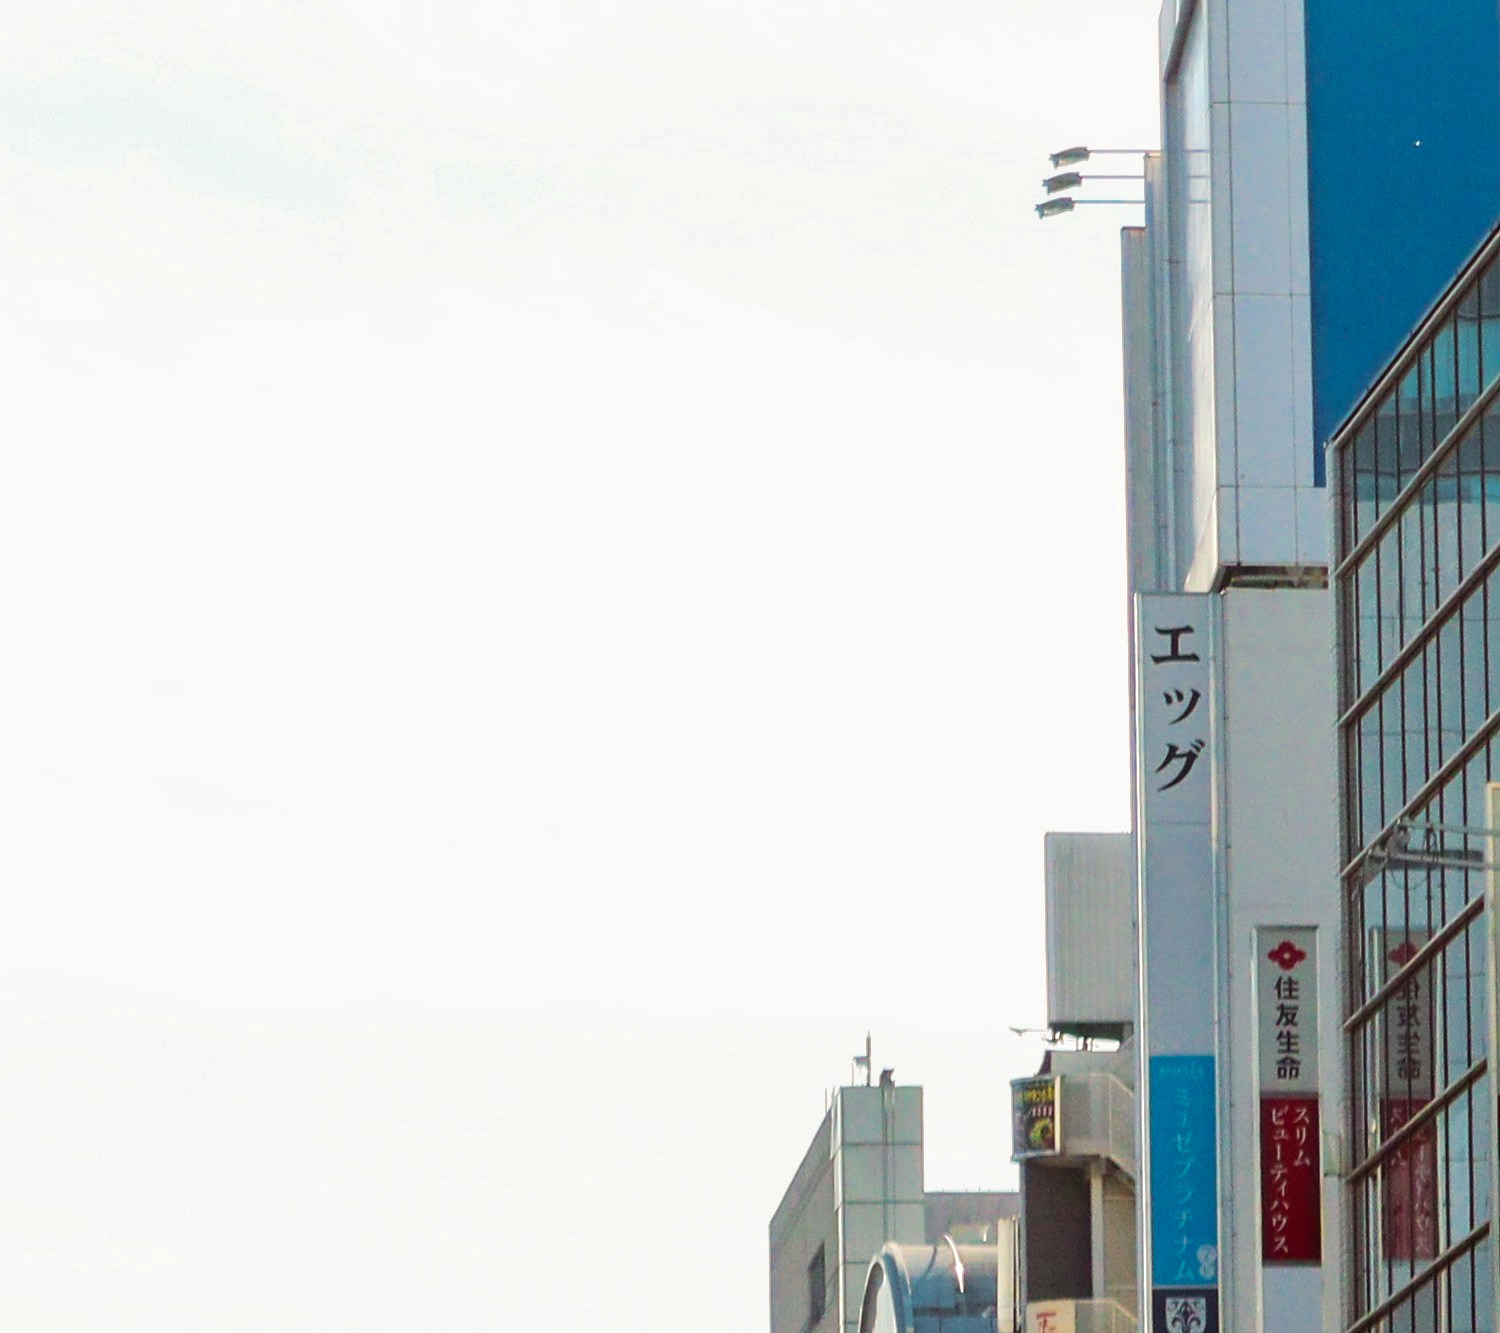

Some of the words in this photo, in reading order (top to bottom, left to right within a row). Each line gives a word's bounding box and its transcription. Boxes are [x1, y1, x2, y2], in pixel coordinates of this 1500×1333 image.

[1151, 625, 1207, 795] エッグ
[1274, 975, 1303, 1082] 住友生命
[1271, 1106, 1290, 1256] ビューティハウス
[1291, 1106, 1311, 1167] スリム
